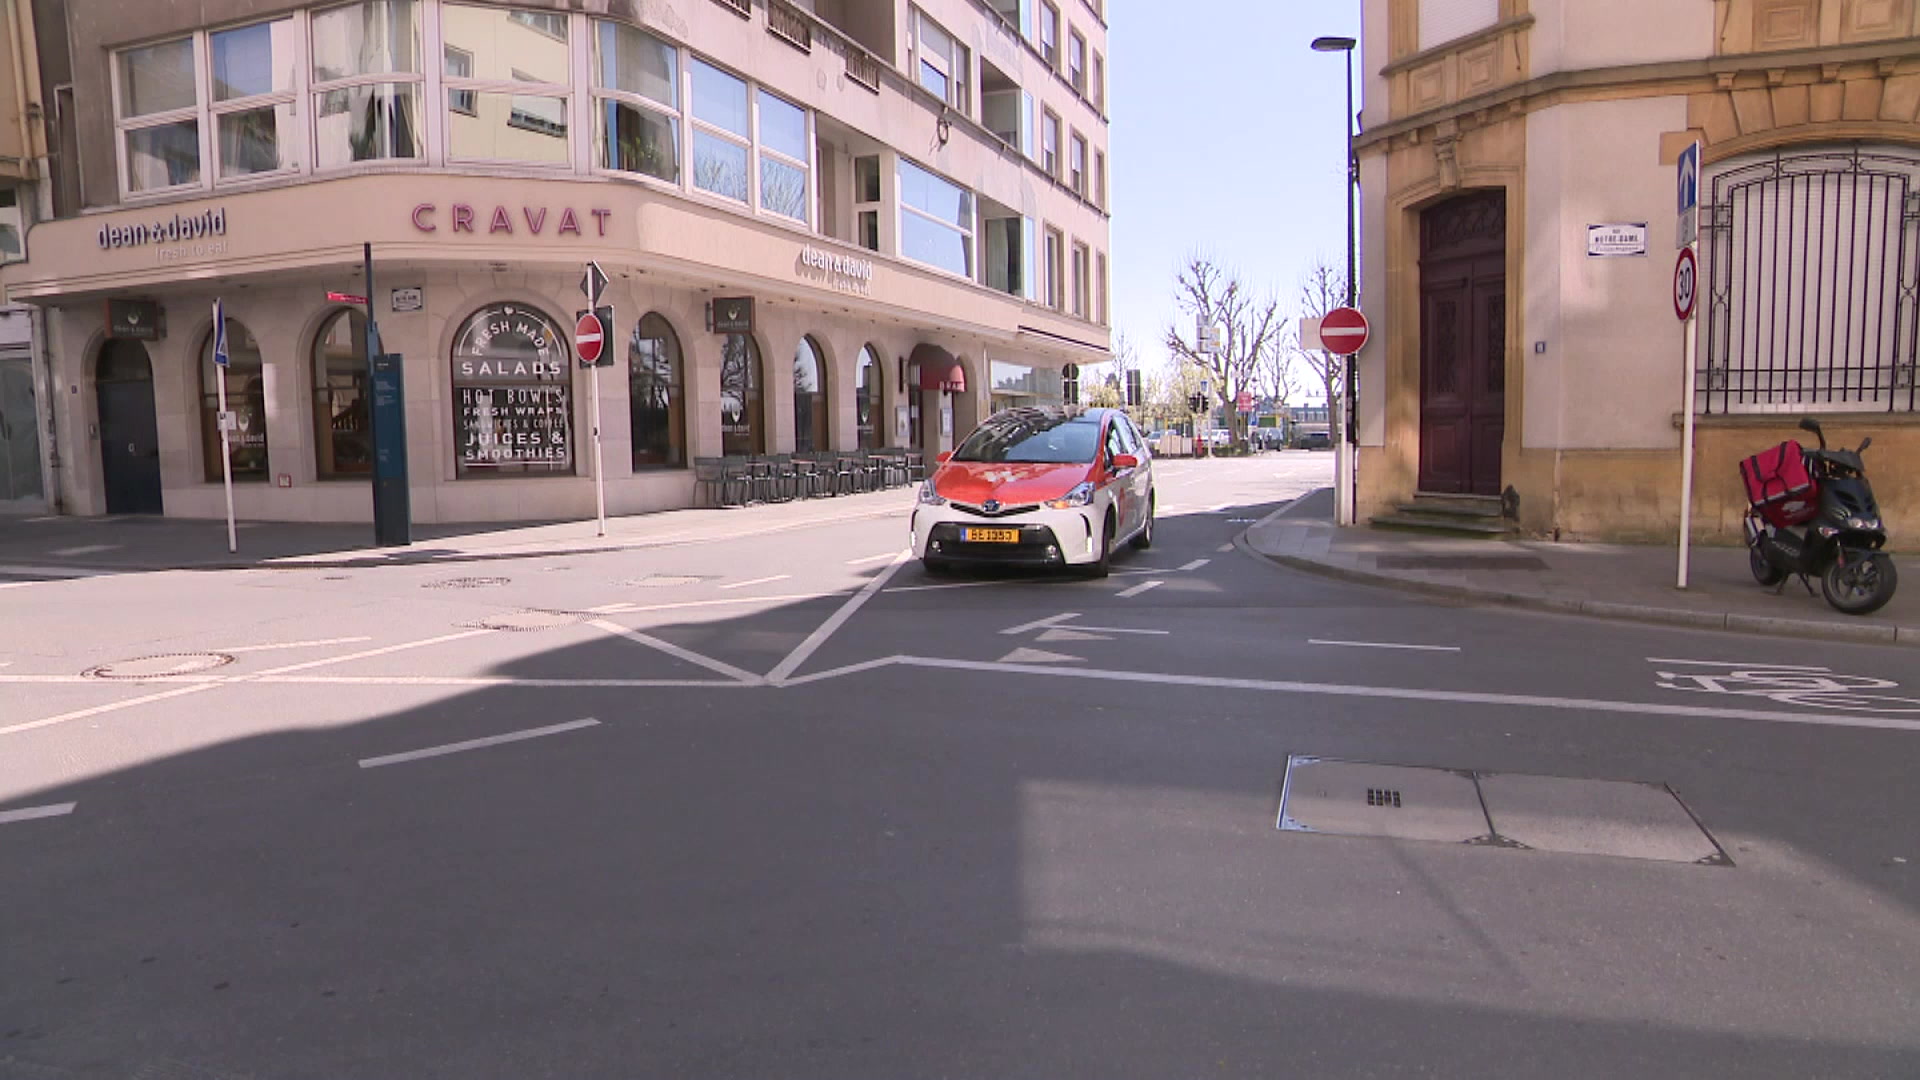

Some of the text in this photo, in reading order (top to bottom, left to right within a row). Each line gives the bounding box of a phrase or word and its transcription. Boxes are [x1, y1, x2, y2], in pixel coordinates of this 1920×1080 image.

[97, 207, 226, 249] dean & david
[411, 203, 612, 236] CRAVAT
[801, 243, 872, 280] dean & david
[1679, 267, 1690, 301] 30
[471, 321, 549, 357] FRESH MADE
[461, 361, 561, 376] SALADS
[463, 388, 563, 405] HOT BOWLS
[463, 406, 564, 417] FRESH WRAPS
[464, 431, 564, 447] JUICES &
[465, 447, 565, 461] SMOOTHIES
